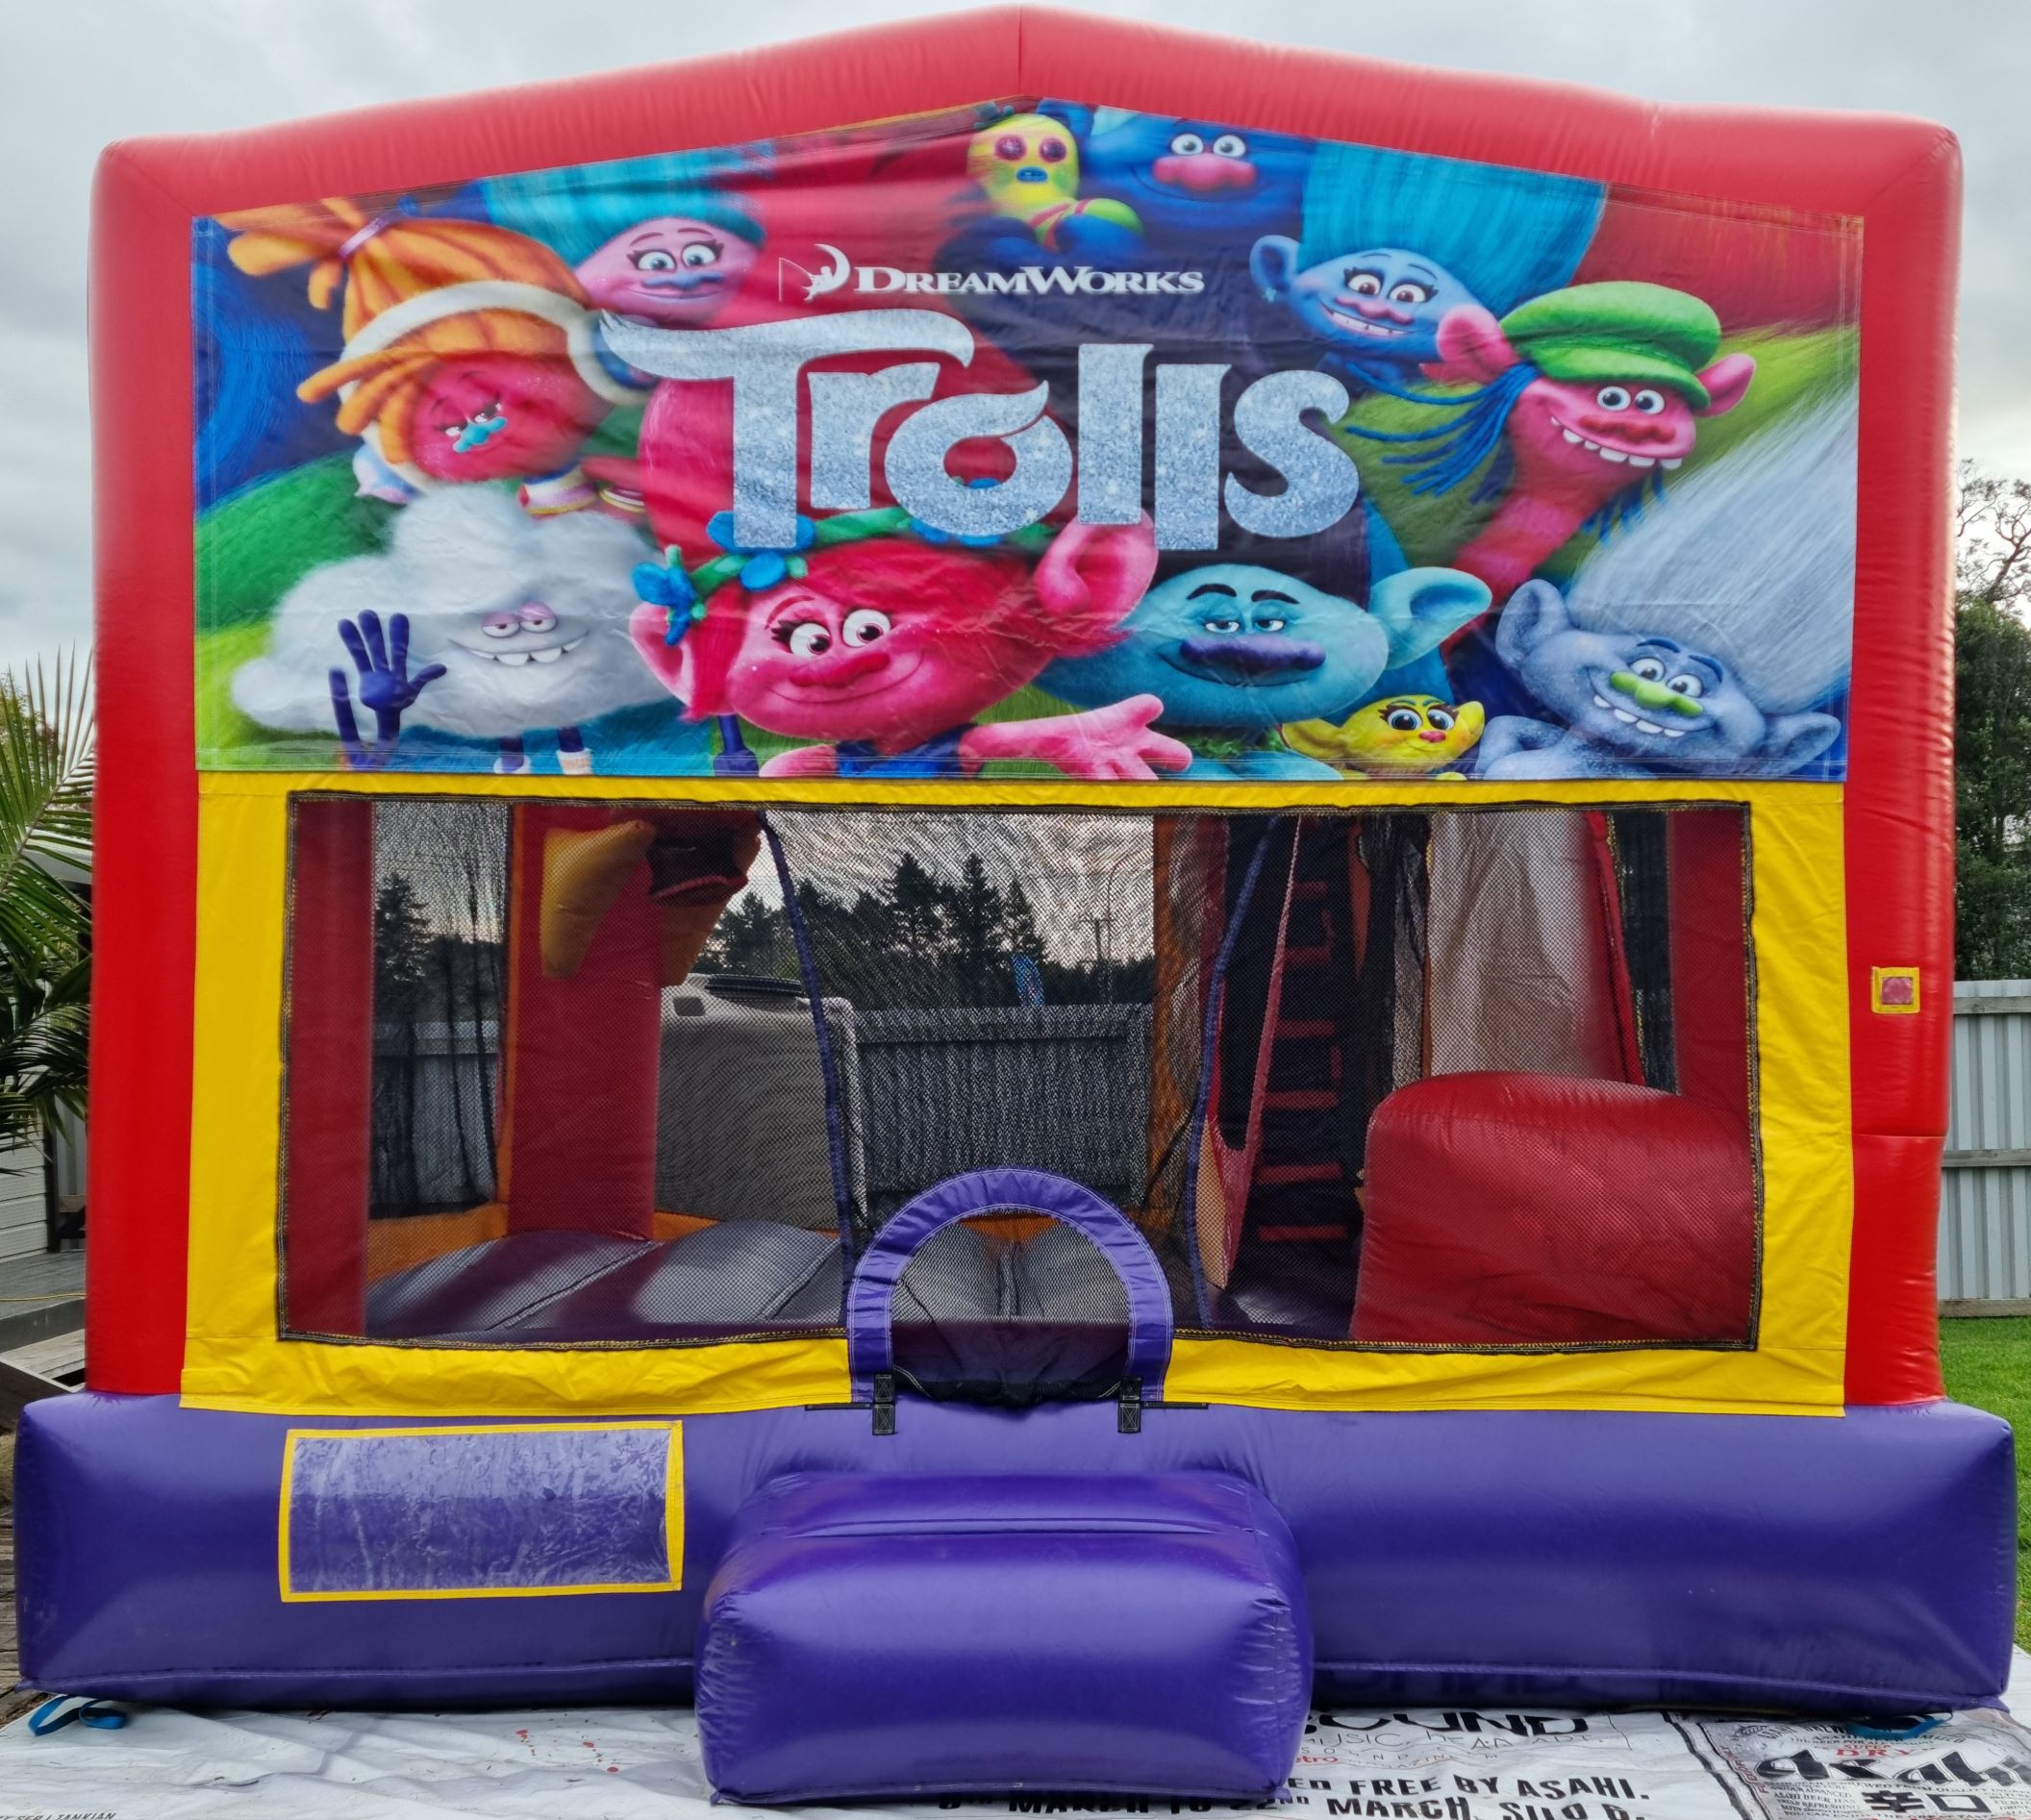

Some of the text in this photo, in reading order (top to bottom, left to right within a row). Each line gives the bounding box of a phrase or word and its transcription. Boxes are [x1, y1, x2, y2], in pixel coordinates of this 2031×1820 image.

[599, 308, 1361, 551] Trolls
[1305, 1711, 1589, 1736] OUND
[1348, 1777, 1442, 1796] FREE
[1453, 1774, 1499, 1794] BY
[1861, 1789, 1992, 1814] 辛口
